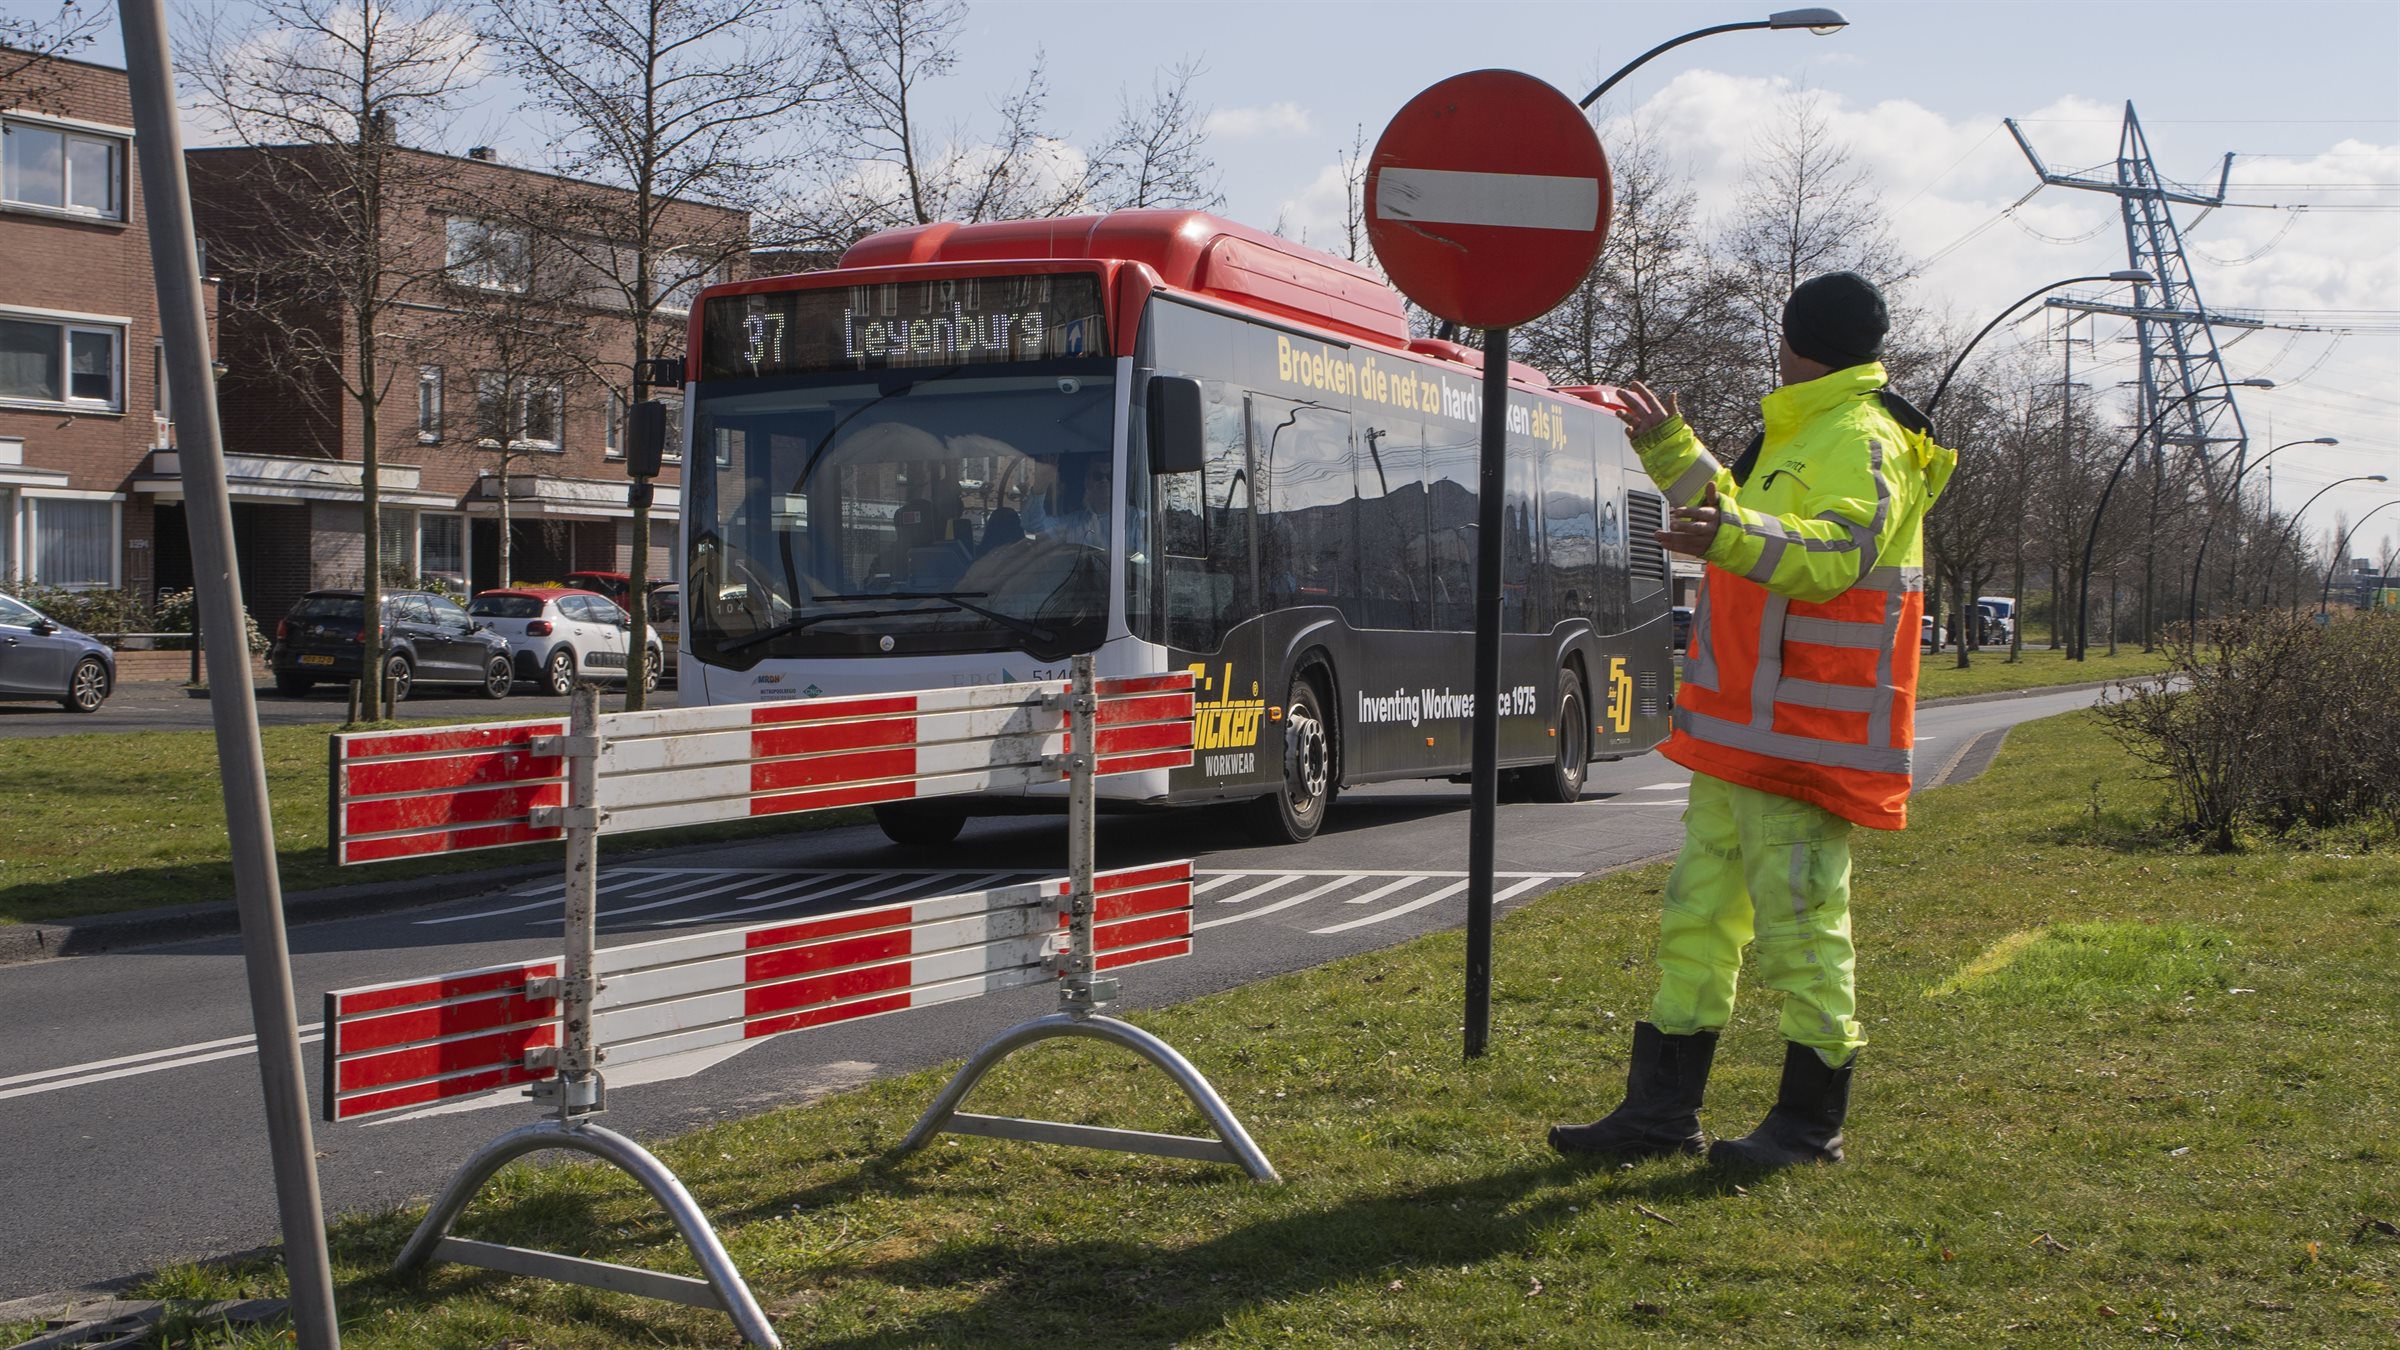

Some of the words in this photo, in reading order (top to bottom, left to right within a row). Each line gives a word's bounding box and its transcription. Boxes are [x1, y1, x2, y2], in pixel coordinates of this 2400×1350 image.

[742, 312, 785, 364] 37
[845, 301, 1043, 359] Leyenburg
[1277, 335, 1356, 397] Broeken
[1360, 357, 1387, 404] die
[1390, 373, 1418, 411] net
[1421, 383, 1440, 415] zo
[1442, 376, 1476, 424] hard
[1531, 401, 1550, 440] als
[1550, 405, 1567, 450] jij.
[716, 602, 745, 615] 104
[1358, 688, 1420, 728] Inventing
[1421, 687, 1475, 720] Workwea
[1512, 686, 1536, 716] 1975
[1205, 752, 1255, 778] WORKWEAR
